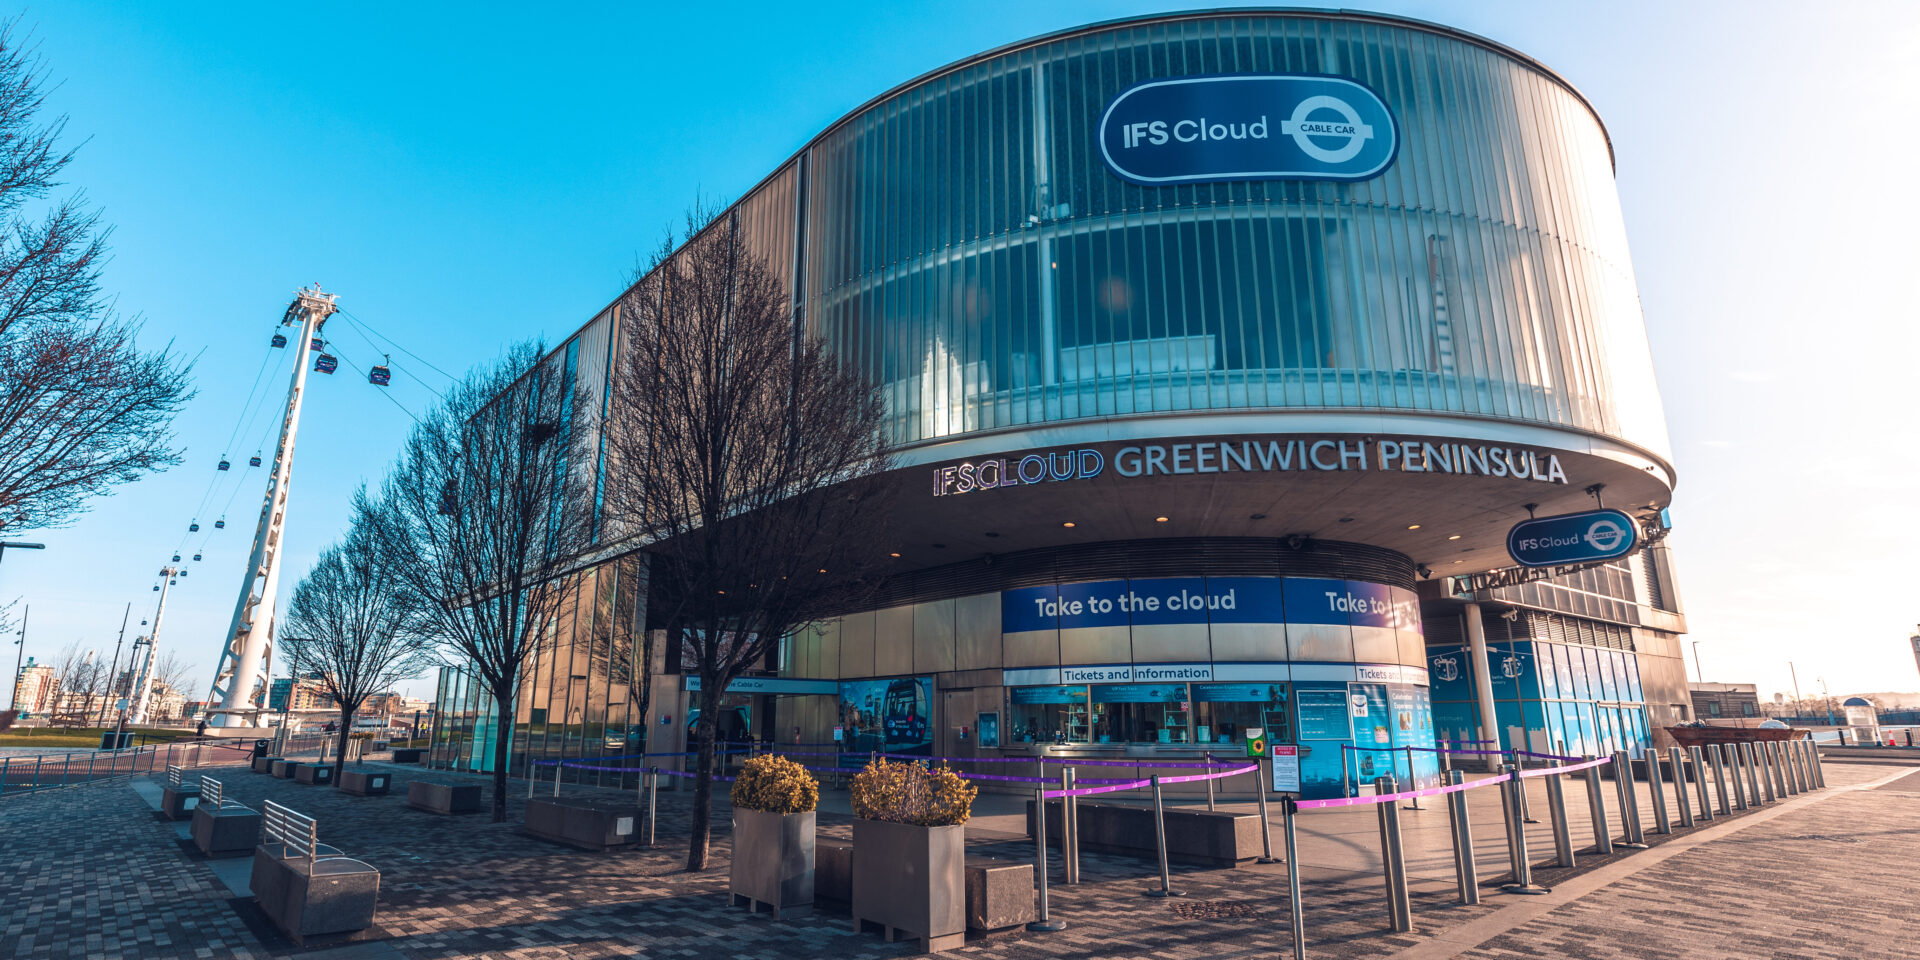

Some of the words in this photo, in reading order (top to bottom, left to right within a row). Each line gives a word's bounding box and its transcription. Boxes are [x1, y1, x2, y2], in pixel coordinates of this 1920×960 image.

[1123, 120, 1169, 149] IFS
[1173, 115, 1268, 143] Cloud
[1300, 123, 1333, 133] CABLE
[1334, 125, 1356, 135] CAR
[1114, 440, 1368, 477] GREENWICH
[1377, 440, 1569, 485] PENINSULA
[1519, 539, 1538, 551] IFS
[1539, 533, 1579, 548] Cloud
[1035, 596, 1083, 617] Take
[1088, 596, 1113, 613] to
[1117, 591, 1160, 612] the
[1166, 588, 1236, 611] cloud
[1325, 591, 1367, 613] Take
[1370, 597, 1386, 614] to
[1064, 670, 1104, 681] Tickets
[1107, 669, 1130, 680] and
[1134, 667, 1210, 680] information
[1359, 668, 1387, 679] Tickets
